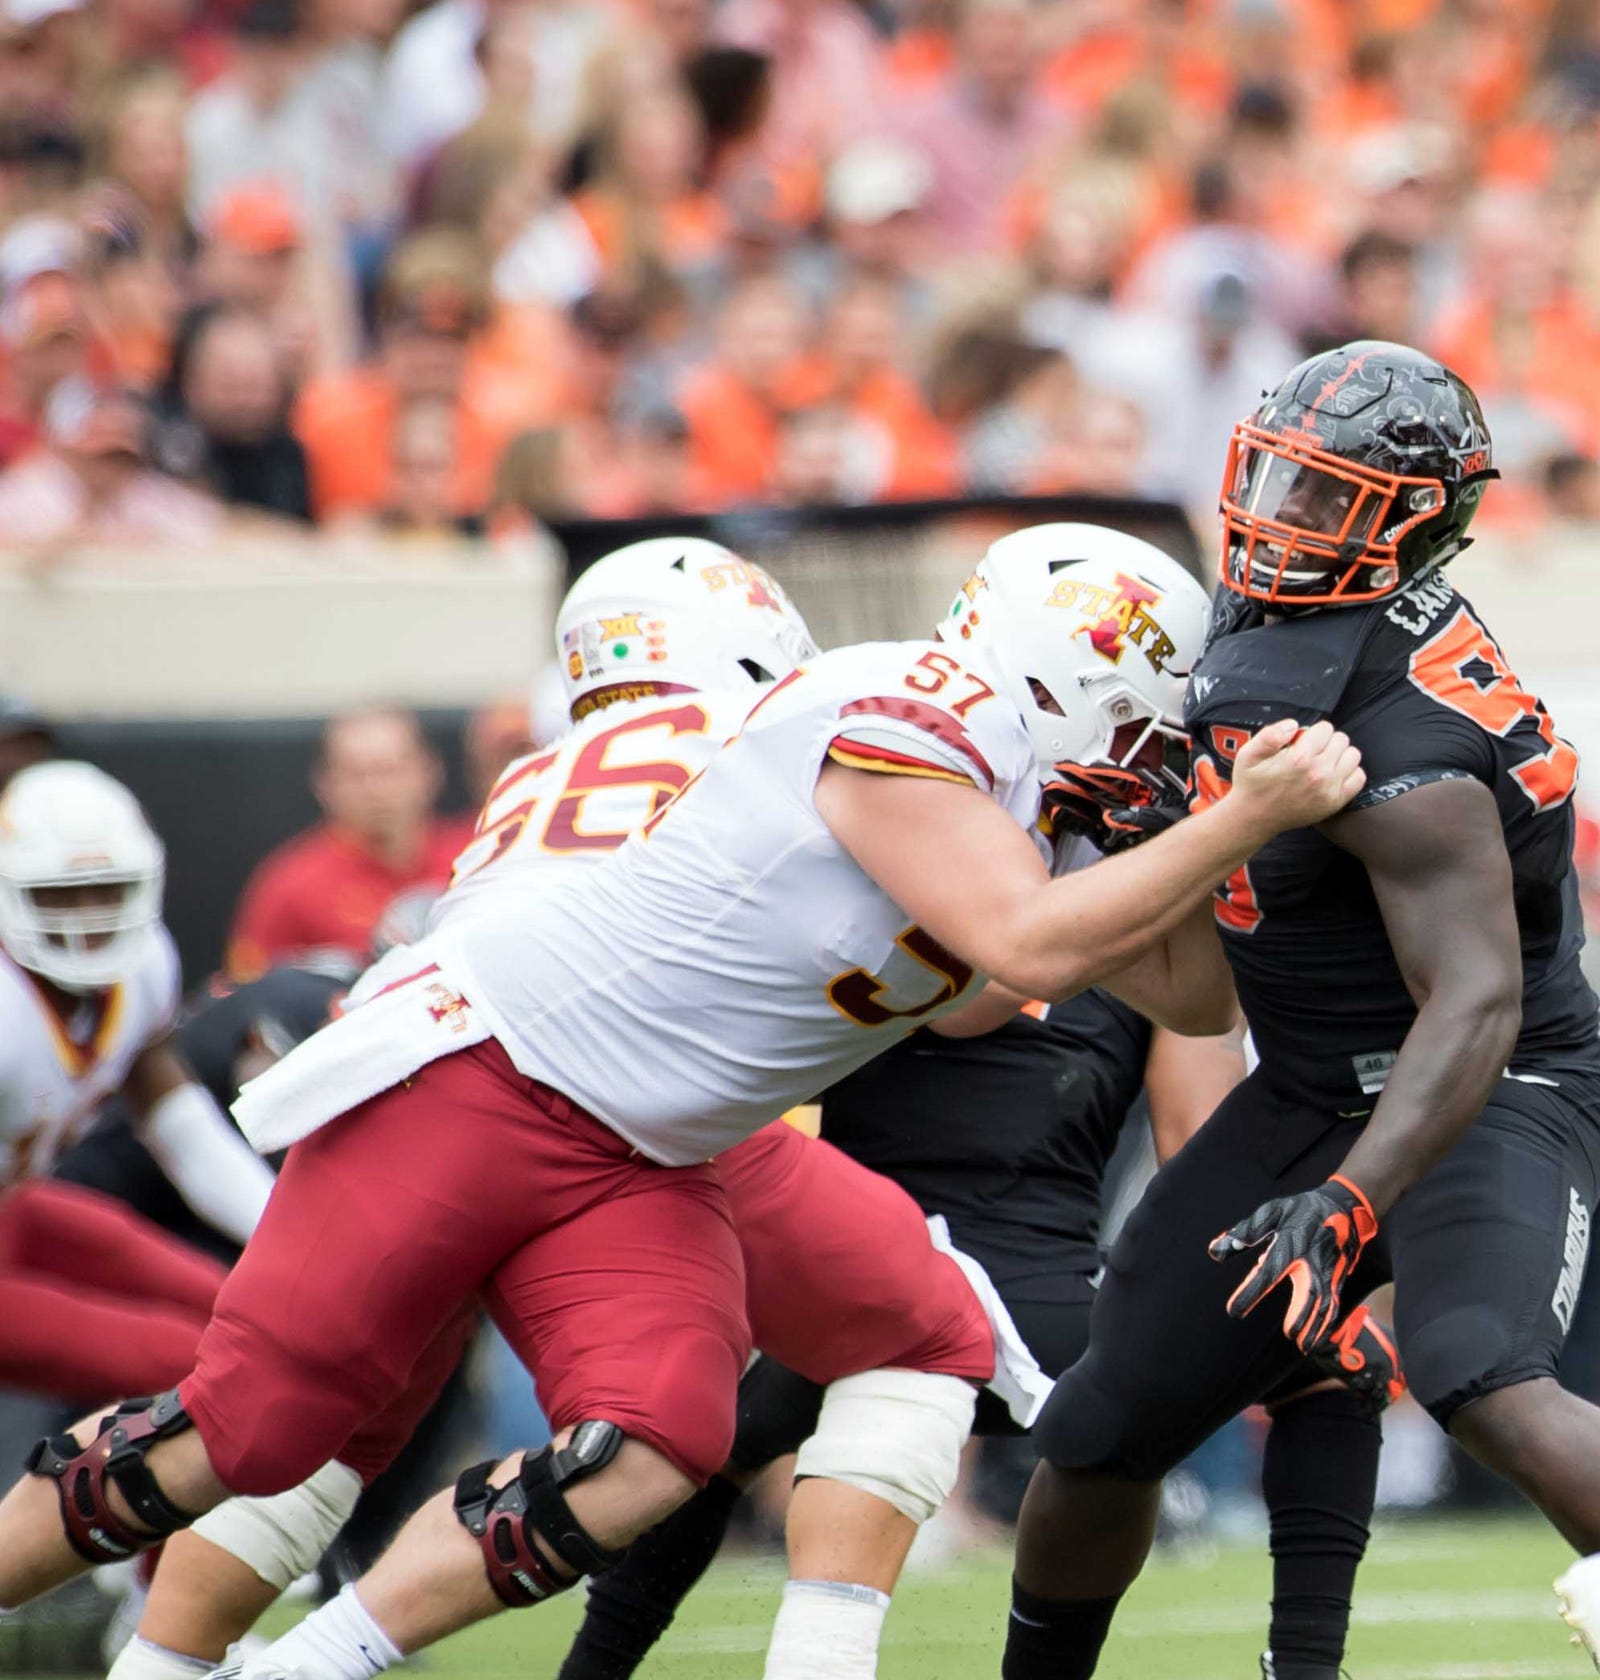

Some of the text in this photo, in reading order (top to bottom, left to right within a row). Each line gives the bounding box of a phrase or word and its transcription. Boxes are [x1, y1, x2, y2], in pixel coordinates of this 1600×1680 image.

[1043, 578, 1177, 675] STATE
[904, 650, 996, 719] 57
[449, 703, 713, 891] 56
